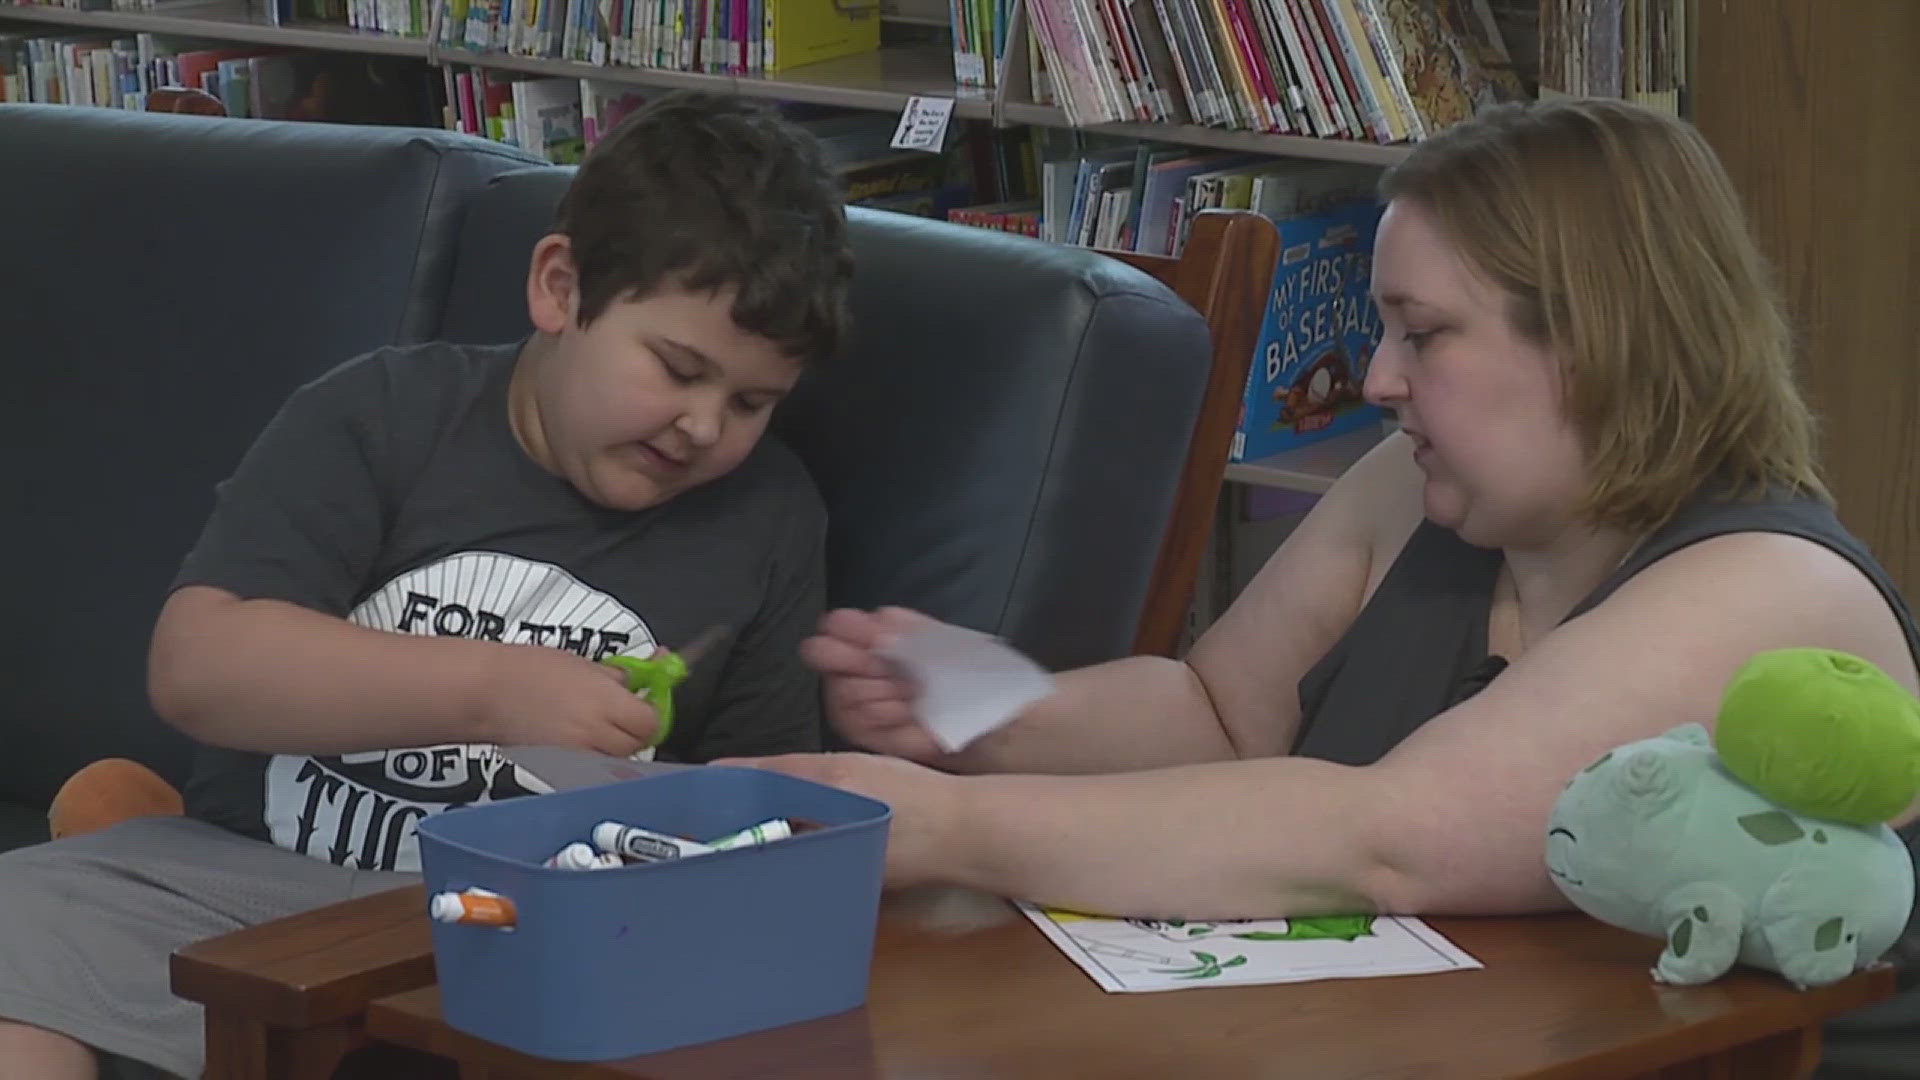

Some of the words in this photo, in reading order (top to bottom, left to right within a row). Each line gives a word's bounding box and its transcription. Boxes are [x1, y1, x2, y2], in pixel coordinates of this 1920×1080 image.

[1273, 273, 1297, 312] MY
[1279, 305, 1294, 330] OF
[398, 591, 504, 642] FOR
[520, 621, 629, 662] THE
[394, 747, 462, 780] OF
